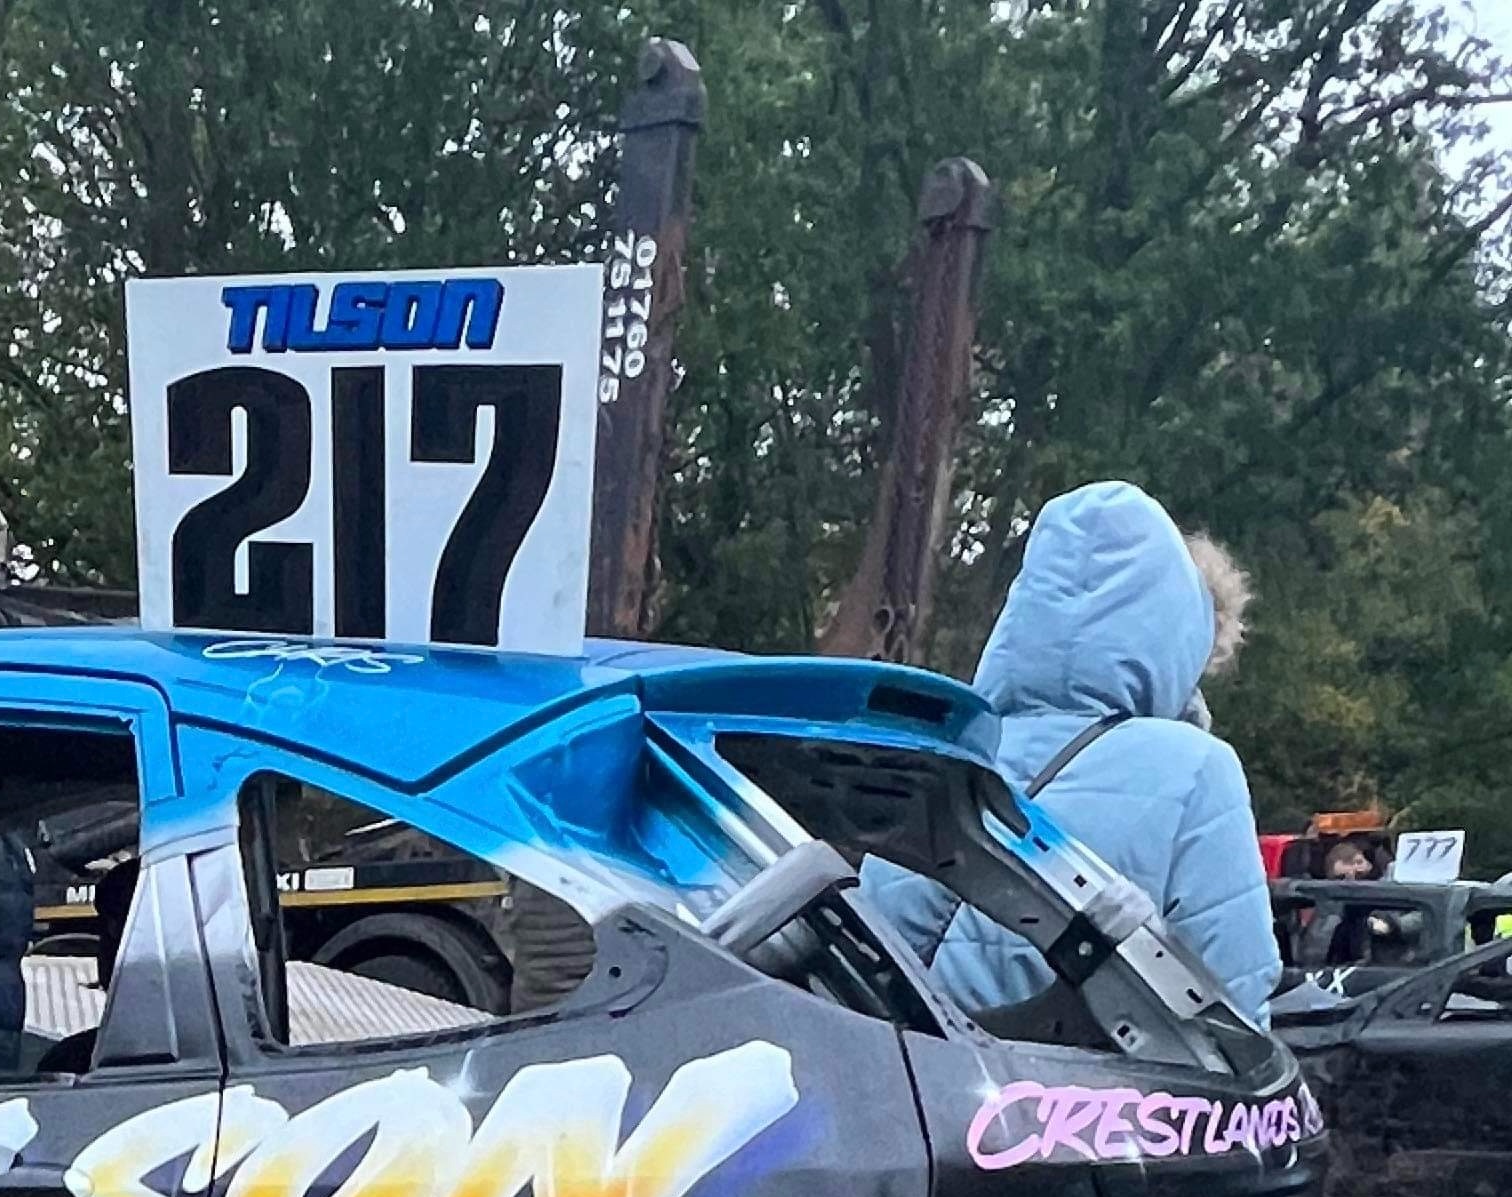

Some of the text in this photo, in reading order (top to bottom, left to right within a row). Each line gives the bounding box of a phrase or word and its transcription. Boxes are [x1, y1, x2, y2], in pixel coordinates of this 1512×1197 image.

[221, 277, 504, 354] TILSON
[620, 235, 658, 379] 01760
[166, 362, 564, 648] 217
[1406, 835, 1458, 863] 777
[966, 1080, 1302, 1170] CRESTLANDS
